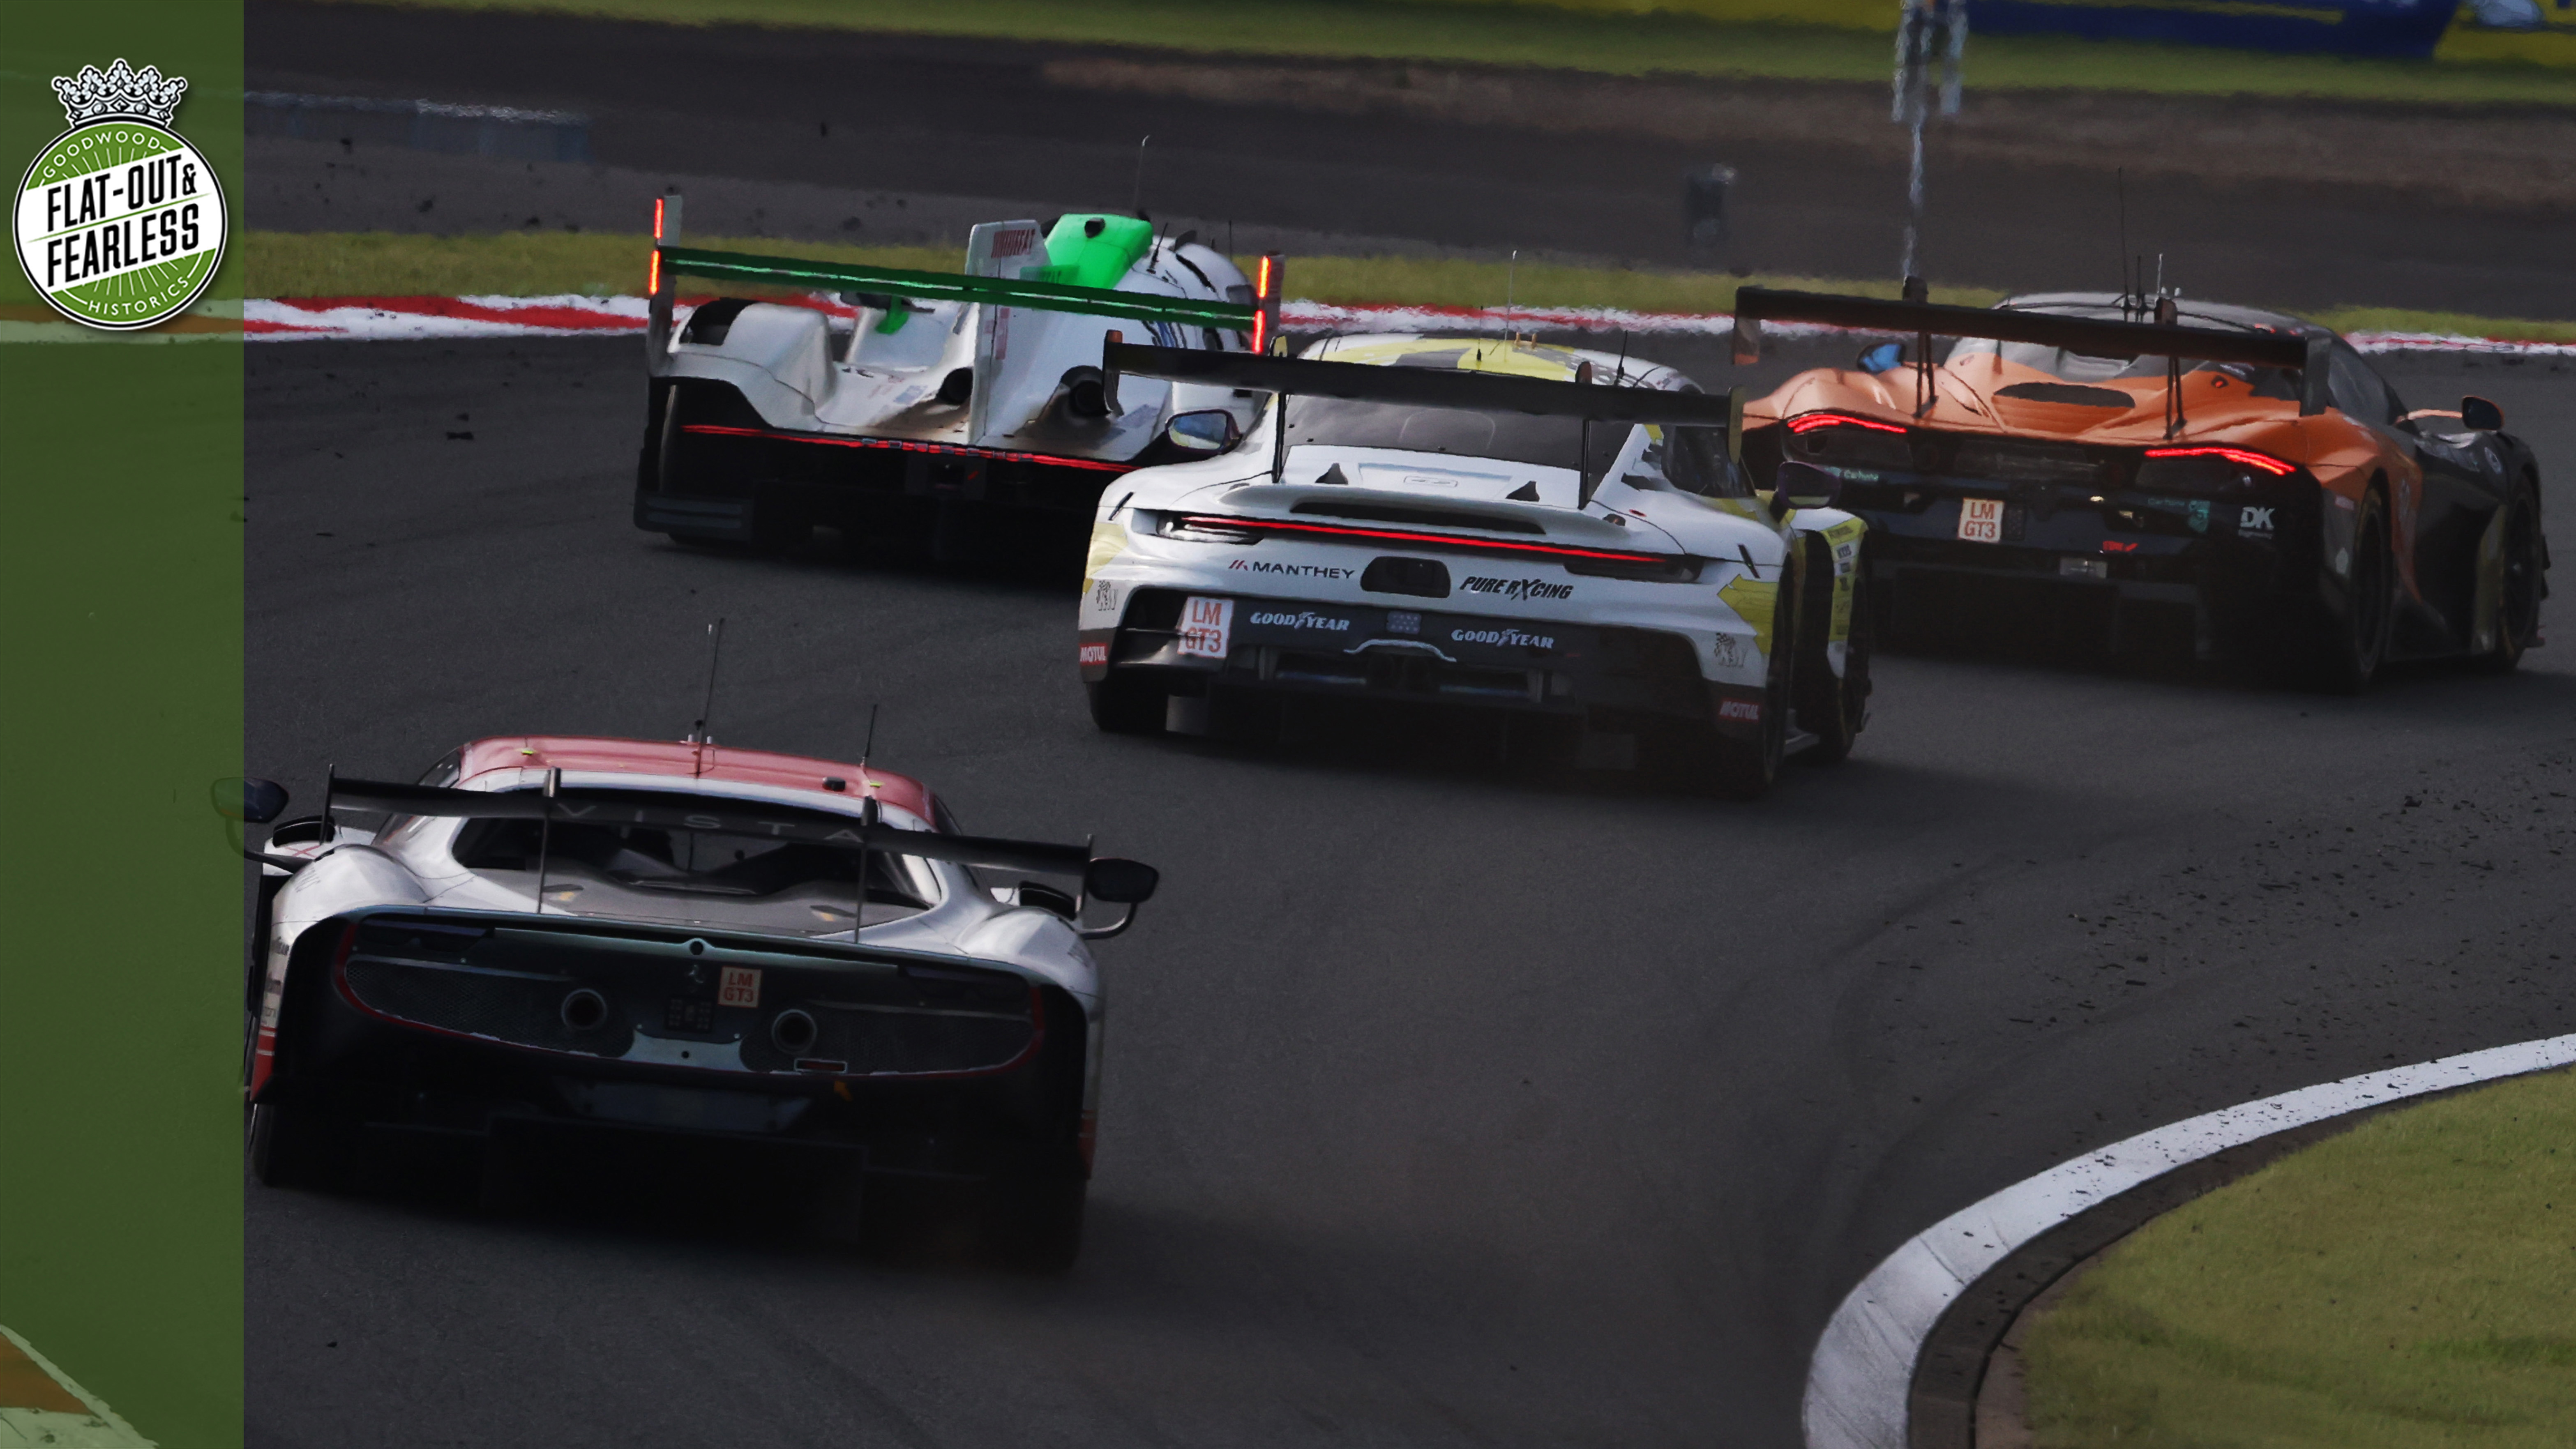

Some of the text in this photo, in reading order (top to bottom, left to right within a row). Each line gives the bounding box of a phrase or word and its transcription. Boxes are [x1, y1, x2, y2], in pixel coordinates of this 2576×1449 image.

[1970, 502, 1995, 520] LM
[2239, 506, 2275, 530] DK
[1964, 520, 1996, 539] GT3
[1252, 561, 1356, 579] MANTHEY
[1459, 576, 1509, 593] PURE
[1192, 599, 1222, 626] LM
[1250, 611, 1350, 631] GOODYEAR
[1185, 626, 1222, 653] GT3
[1451, 629, 1554, 649] GOODYEAR
[558, 802, 863, 843] VISTA
[728, 972, 754, 988] LM
[724, 986, 754, 1003] GT3
